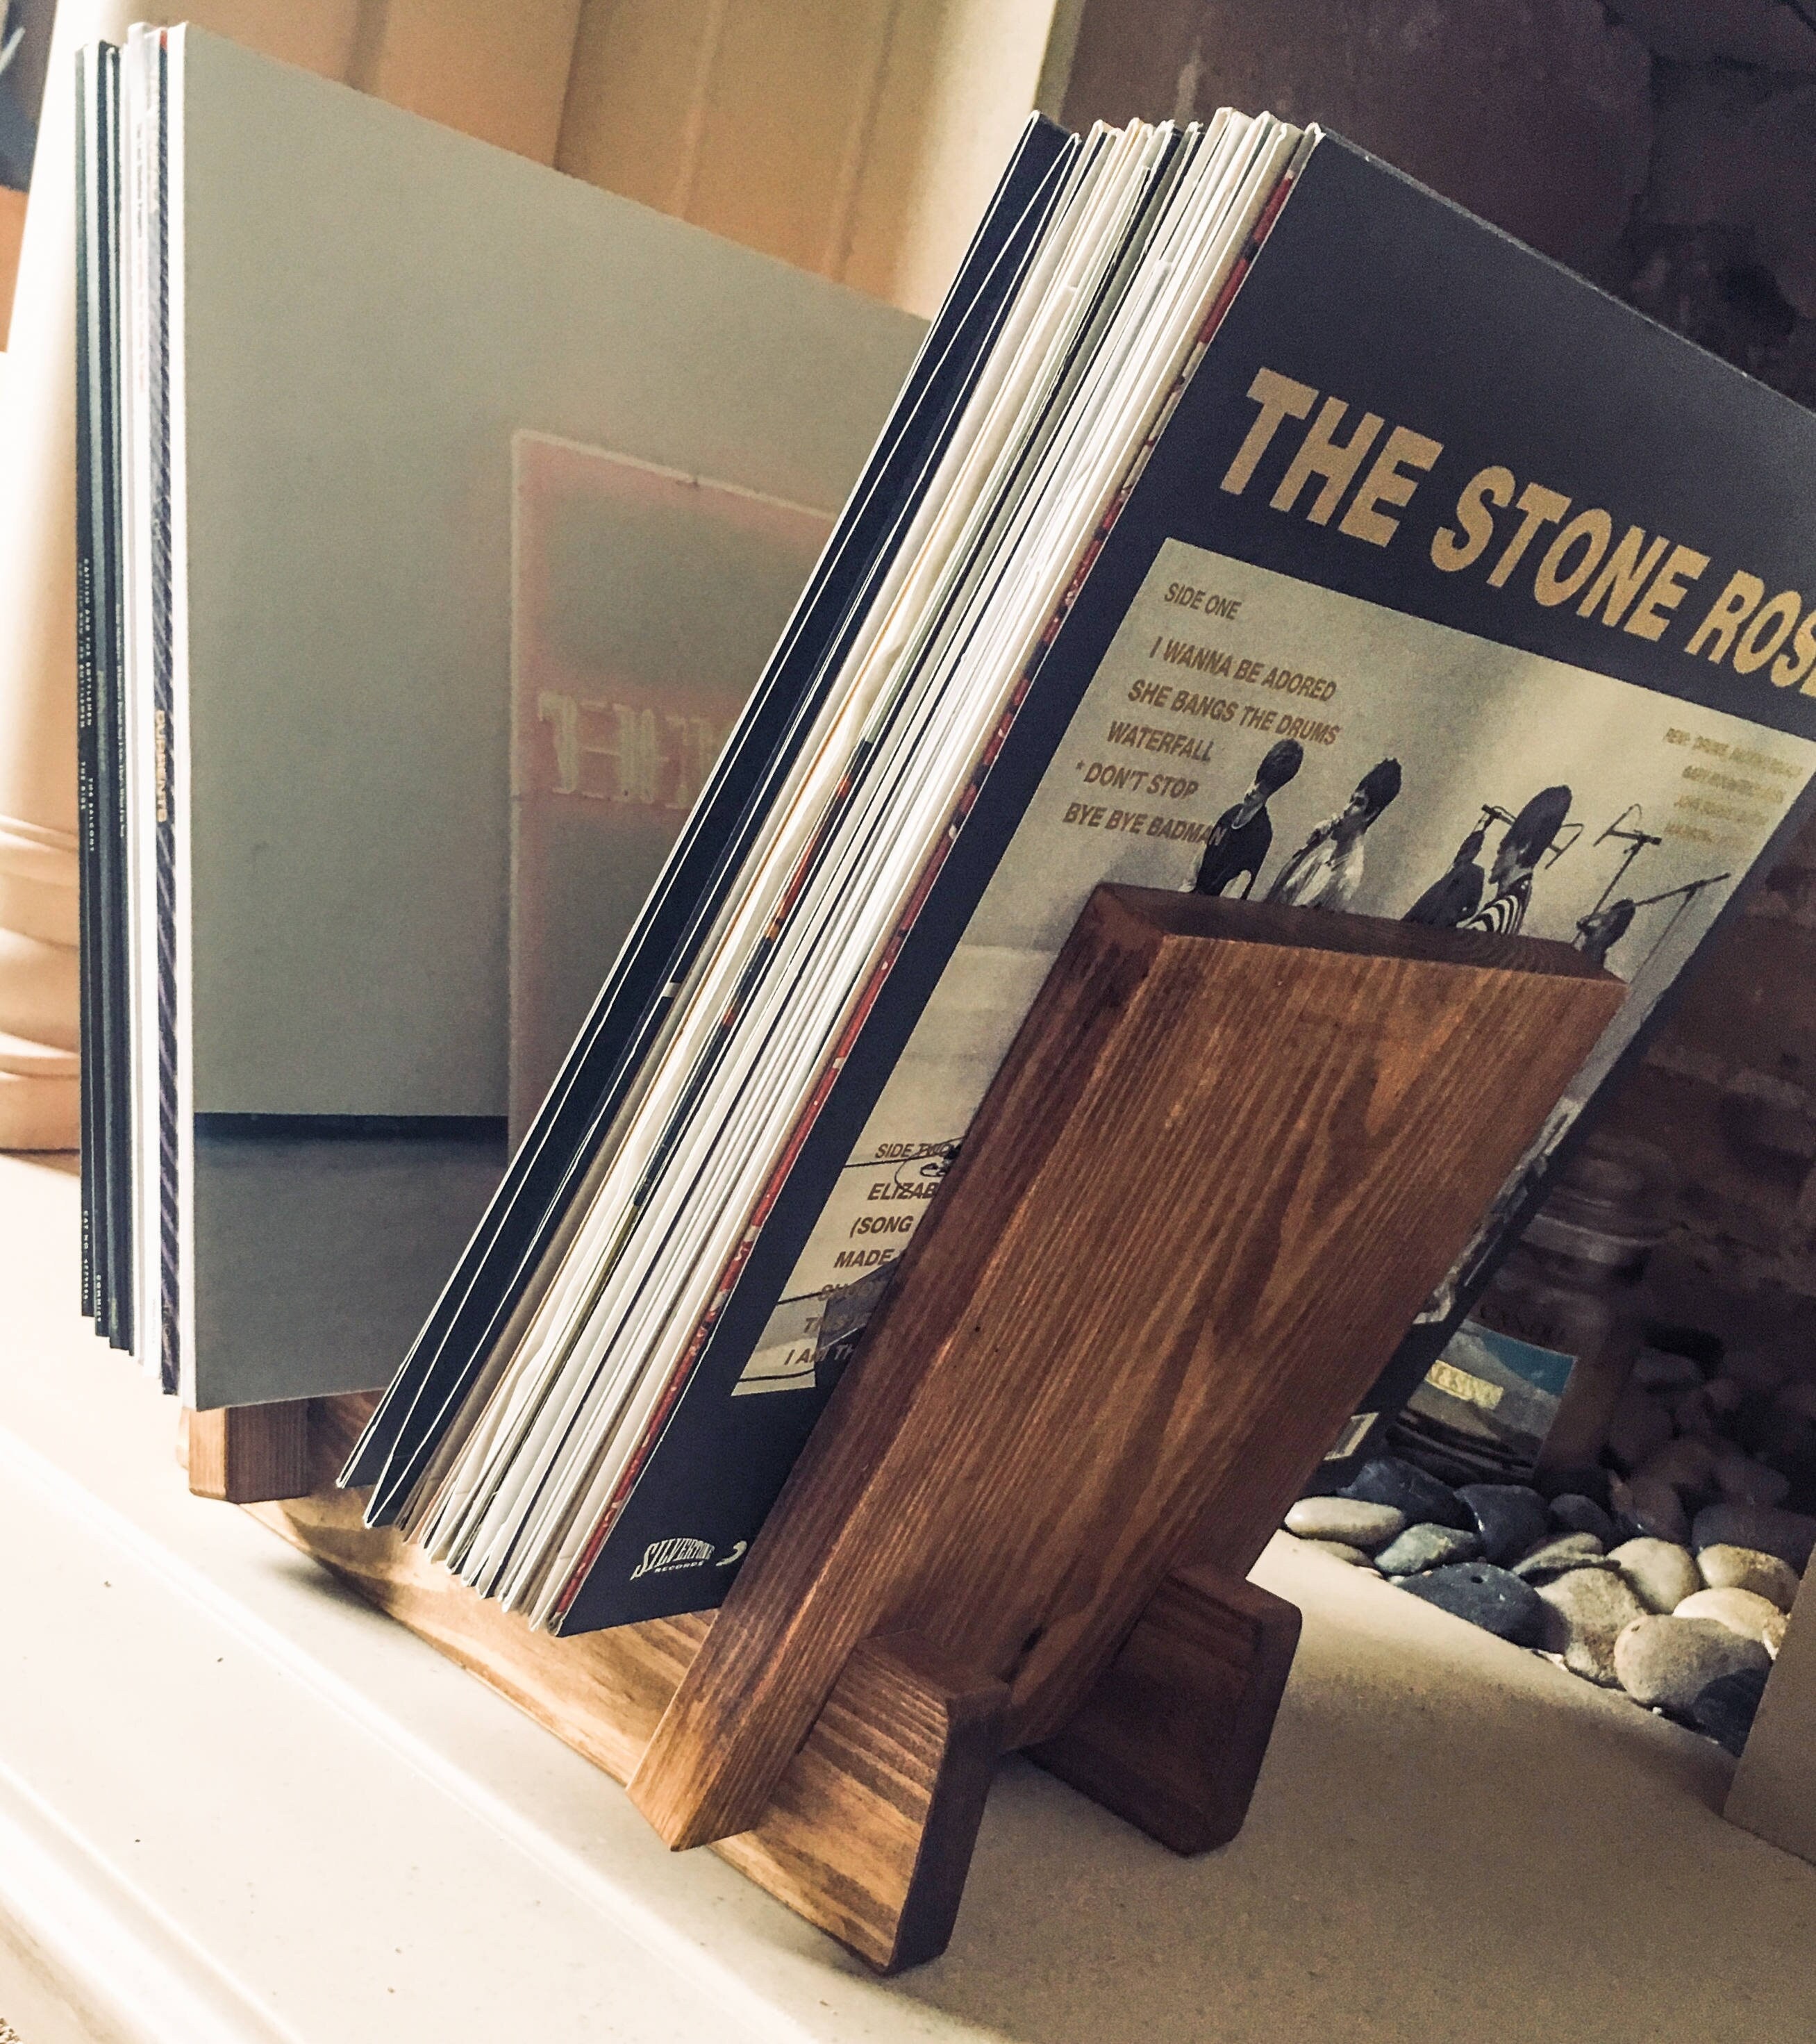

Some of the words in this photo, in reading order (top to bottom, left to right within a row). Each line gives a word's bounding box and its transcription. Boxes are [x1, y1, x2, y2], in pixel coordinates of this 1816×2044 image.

[1220, 367, 1444, 549] THE
[1430, 465, 1712, 641] STONE
[1684, 570, 1816, 699] ROS
[1164, 582, 1206, 611] SIDE
[1206, 594, 1242, 620] ONE
[1149, 636, 1163, 658] I
[1163, 639, 1233, 677] WANNA
[1233, 658, 1265, 685] BE
[1261, 667, 1338, 703] ADORED
[1128, 679, 1173, 708] SHE
[1170, 690, 1239, 724] BANGS
[1238, 705, 1278, 732] THE
[1275, 715, 1342, 747] DRUMS
[1107, 721, 1215, 763] WATERFALL
[1083, 763, 1149, 792] DON'T
[1147, 773, 1199, 799] STOP
[1063, 802, 1107, 829] BYE
[1104, 809, 1147, 835] BYE
[1147, 815, 1228, 847] BADMAN
[875, 1143, 915, 1159] SIDE
[849, 1216, 915, 1238] (SONG
[833, 1249, 896, 1268] MADE
[784, 1349, 796, 1366] I
[629, 1537, 716, 1581] SILVERTONE
[654, 1560, 705, 1574] RECORDS
